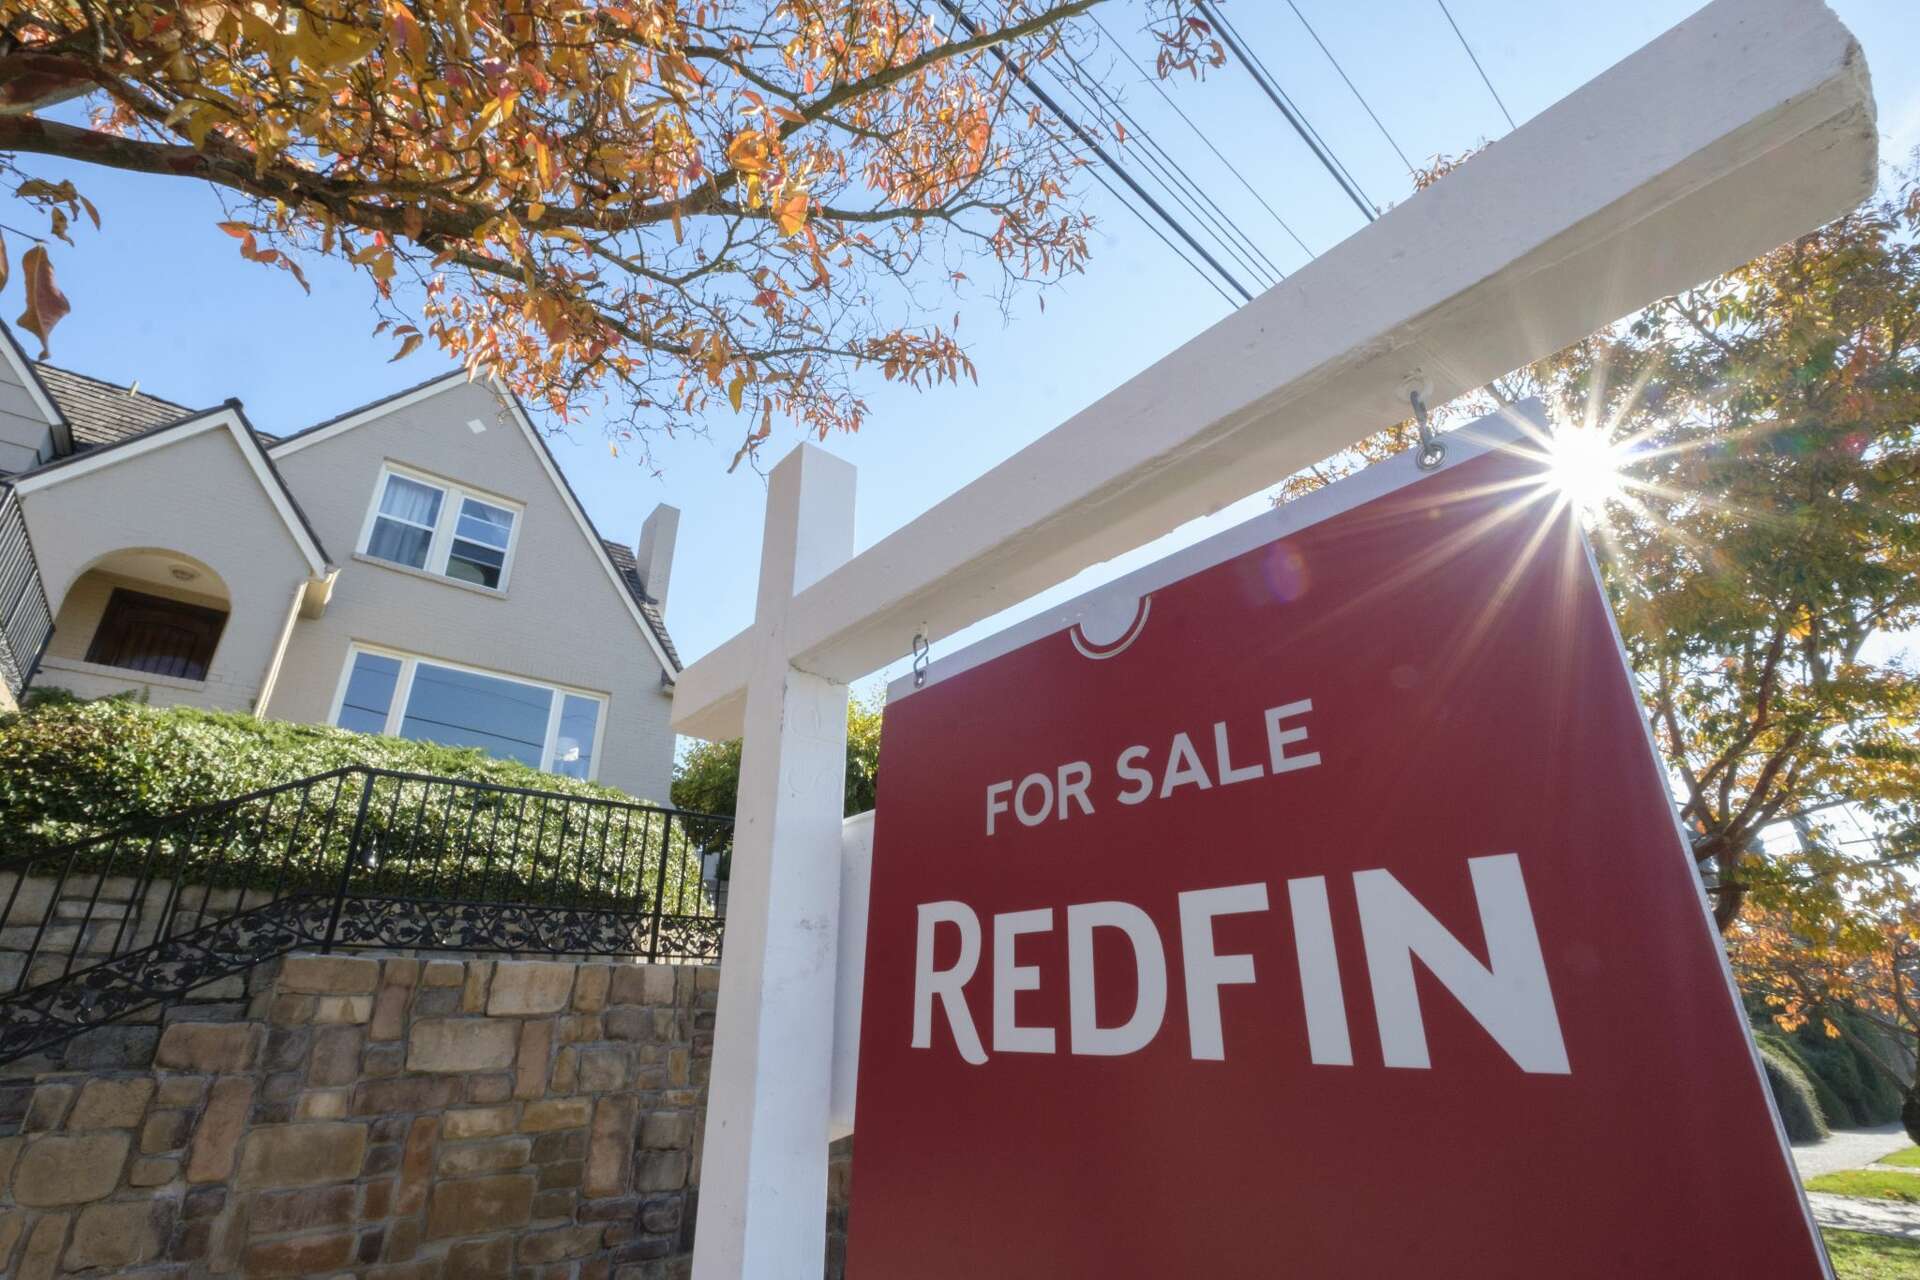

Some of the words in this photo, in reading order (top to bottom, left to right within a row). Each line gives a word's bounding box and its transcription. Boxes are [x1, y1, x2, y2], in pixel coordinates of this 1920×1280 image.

[986, 761, 1094, 836] FOR
[1115, 699, 1322, 805] SALE
[911, 853, 1571, 1075] REDFIN
